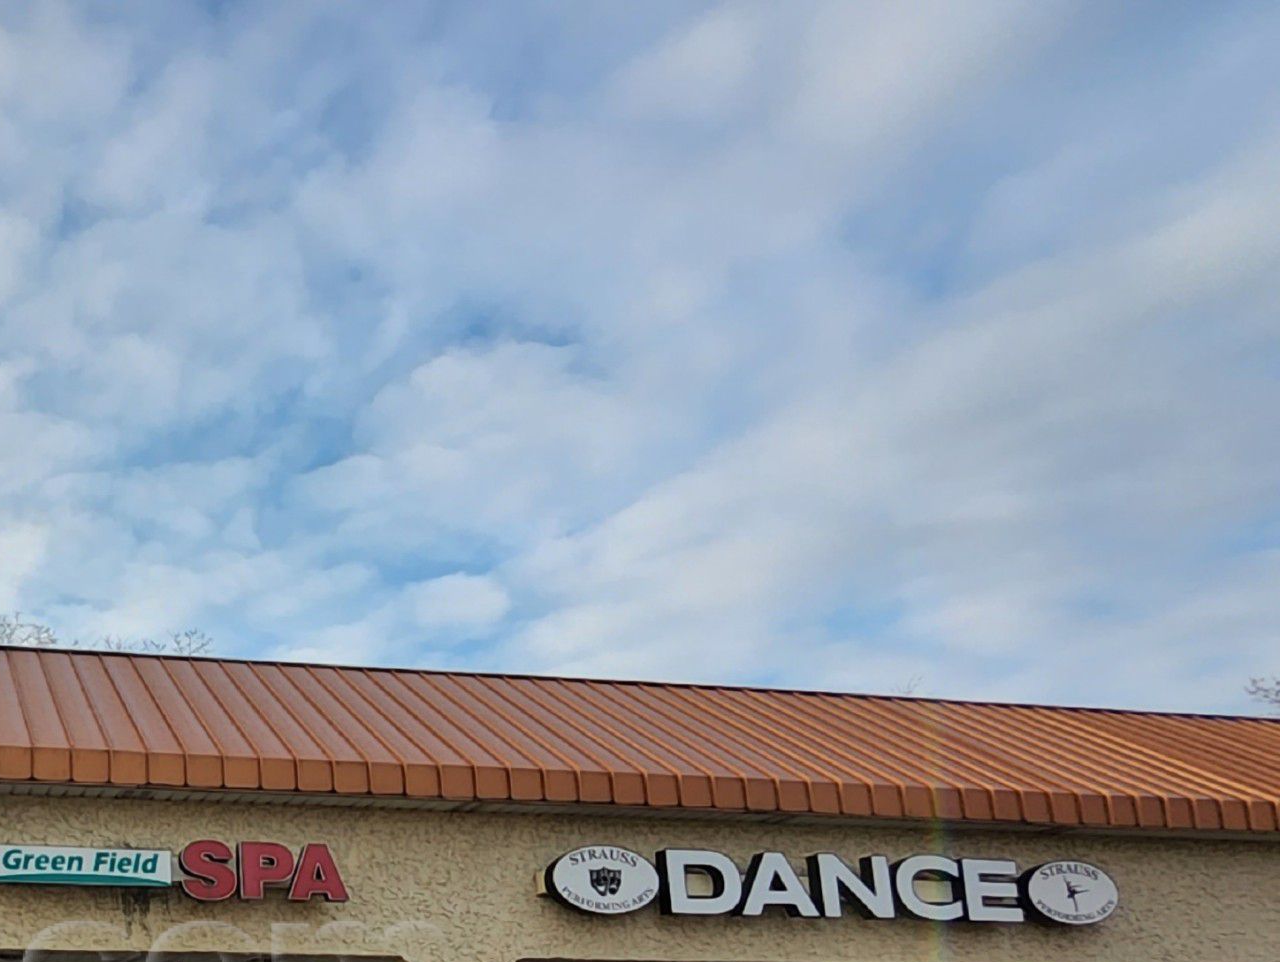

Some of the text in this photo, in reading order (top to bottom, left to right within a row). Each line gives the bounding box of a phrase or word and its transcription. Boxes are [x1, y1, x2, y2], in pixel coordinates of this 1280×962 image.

[1, 849, 159, 875] Green Field
[569, 848, 639, 867] STRAUSS
[180, 839, 350, 902] SPA
[1040, 863, 1099, 881] STRAUSS
[562, 886, 654, 910] PERFORMING ARTS
[664, 848, 1025, 923] DANCE
